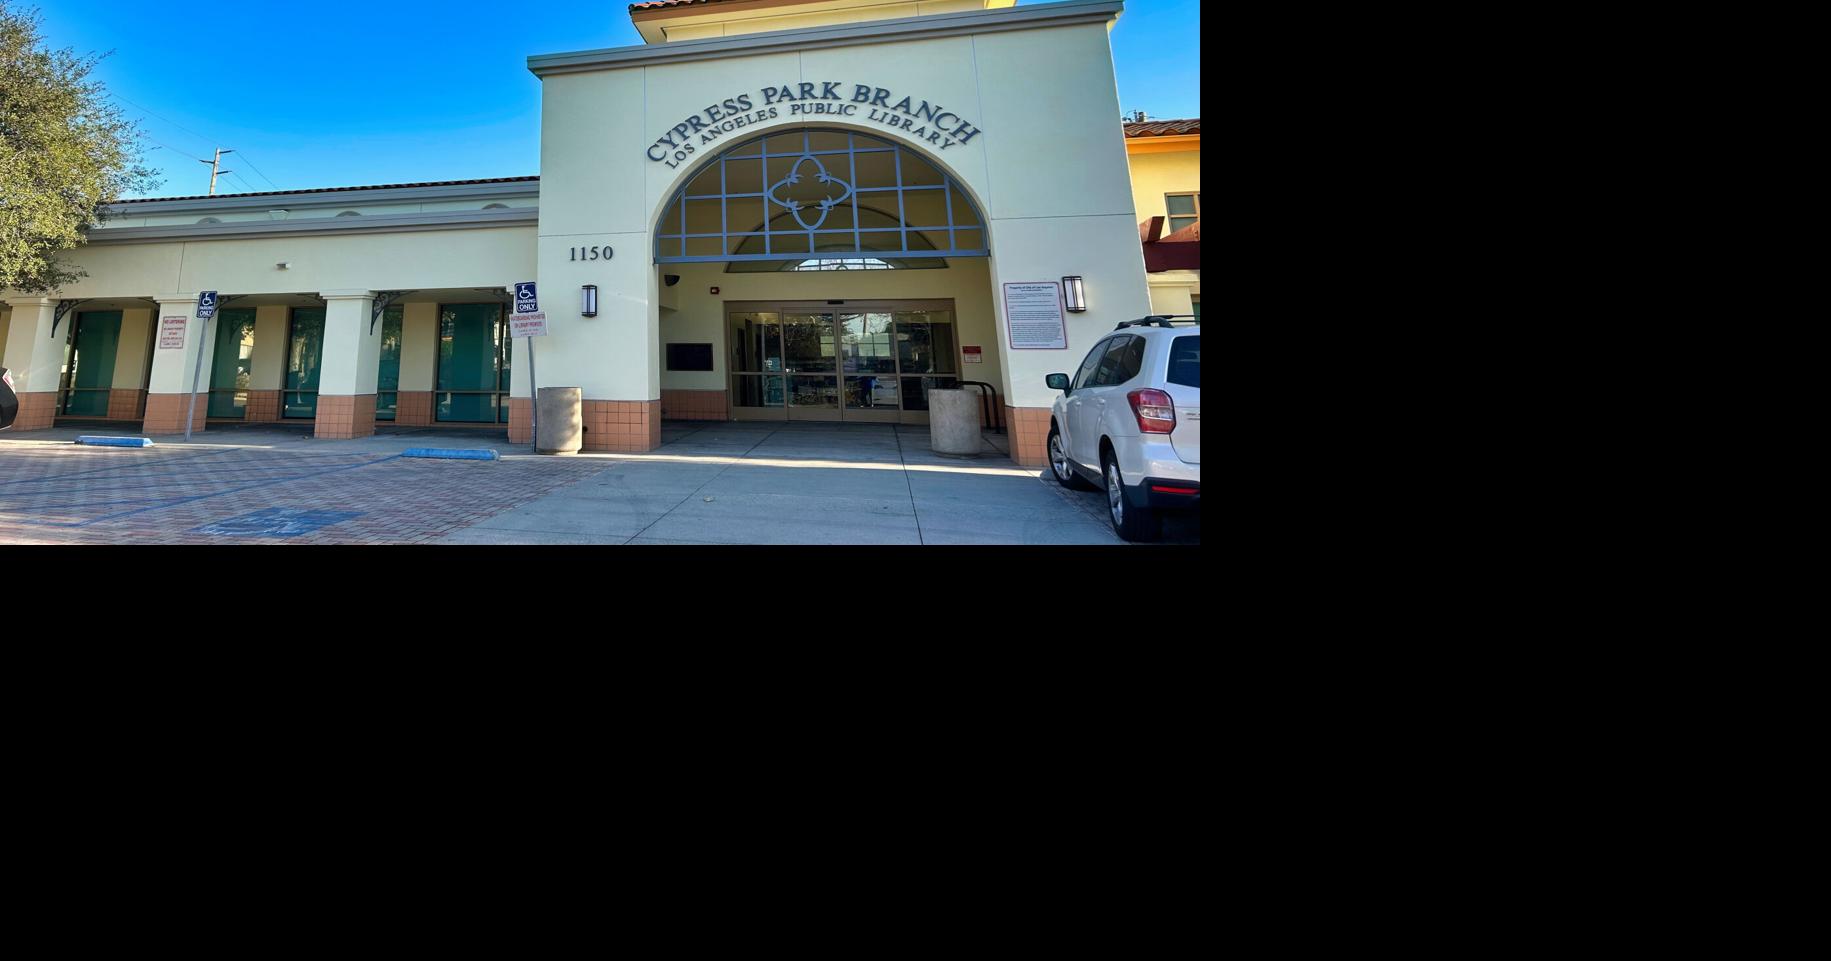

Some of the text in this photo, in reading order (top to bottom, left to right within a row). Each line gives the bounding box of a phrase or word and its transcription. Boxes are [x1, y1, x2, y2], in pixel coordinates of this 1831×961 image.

[647, 81, 982, 162] CYPRESS PARK BRANCH
[665, 102, 957, 169] LOS ANGELES PUBLIC LIBRARY
[570, 246, 614, 261] 1150
[519, 303, 536, 311] ONLY
